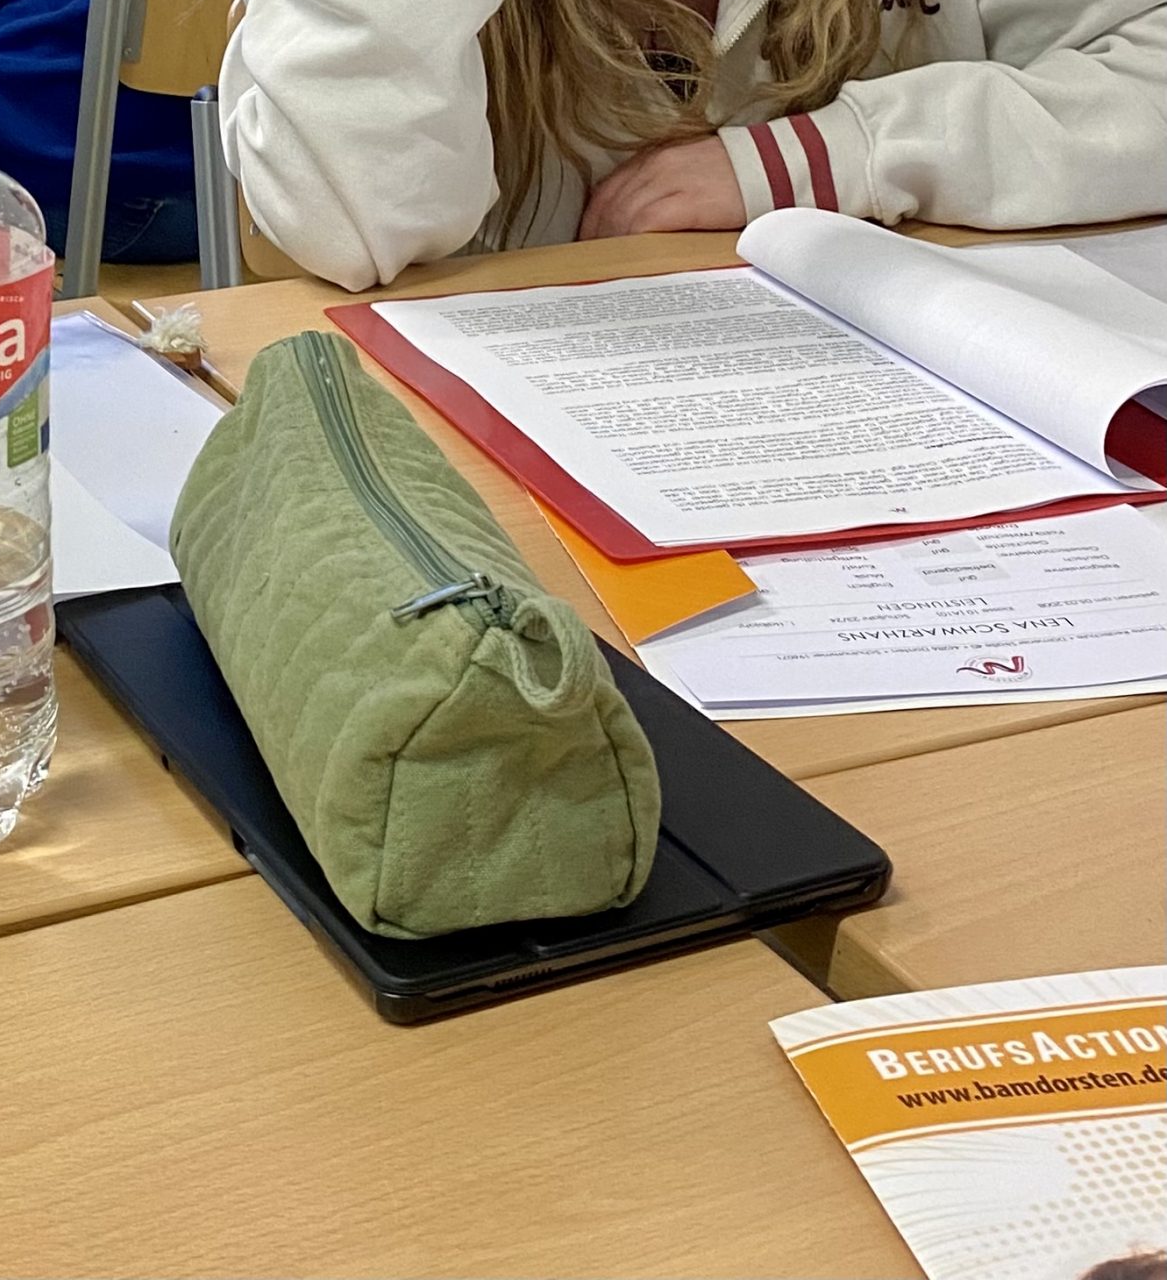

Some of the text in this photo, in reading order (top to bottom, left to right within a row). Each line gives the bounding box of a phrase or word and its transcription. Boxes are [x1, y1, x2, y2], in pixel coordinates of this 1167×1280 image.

[932, 546, 950, 555] gut
[922, 563, 996, 576] befriedigend
[958, 574, 977, 583] gut
[876, 596, 988, 612] LEISTUNGEN
[837, 616, 1074, 642] LENA SCHWARZHANS
